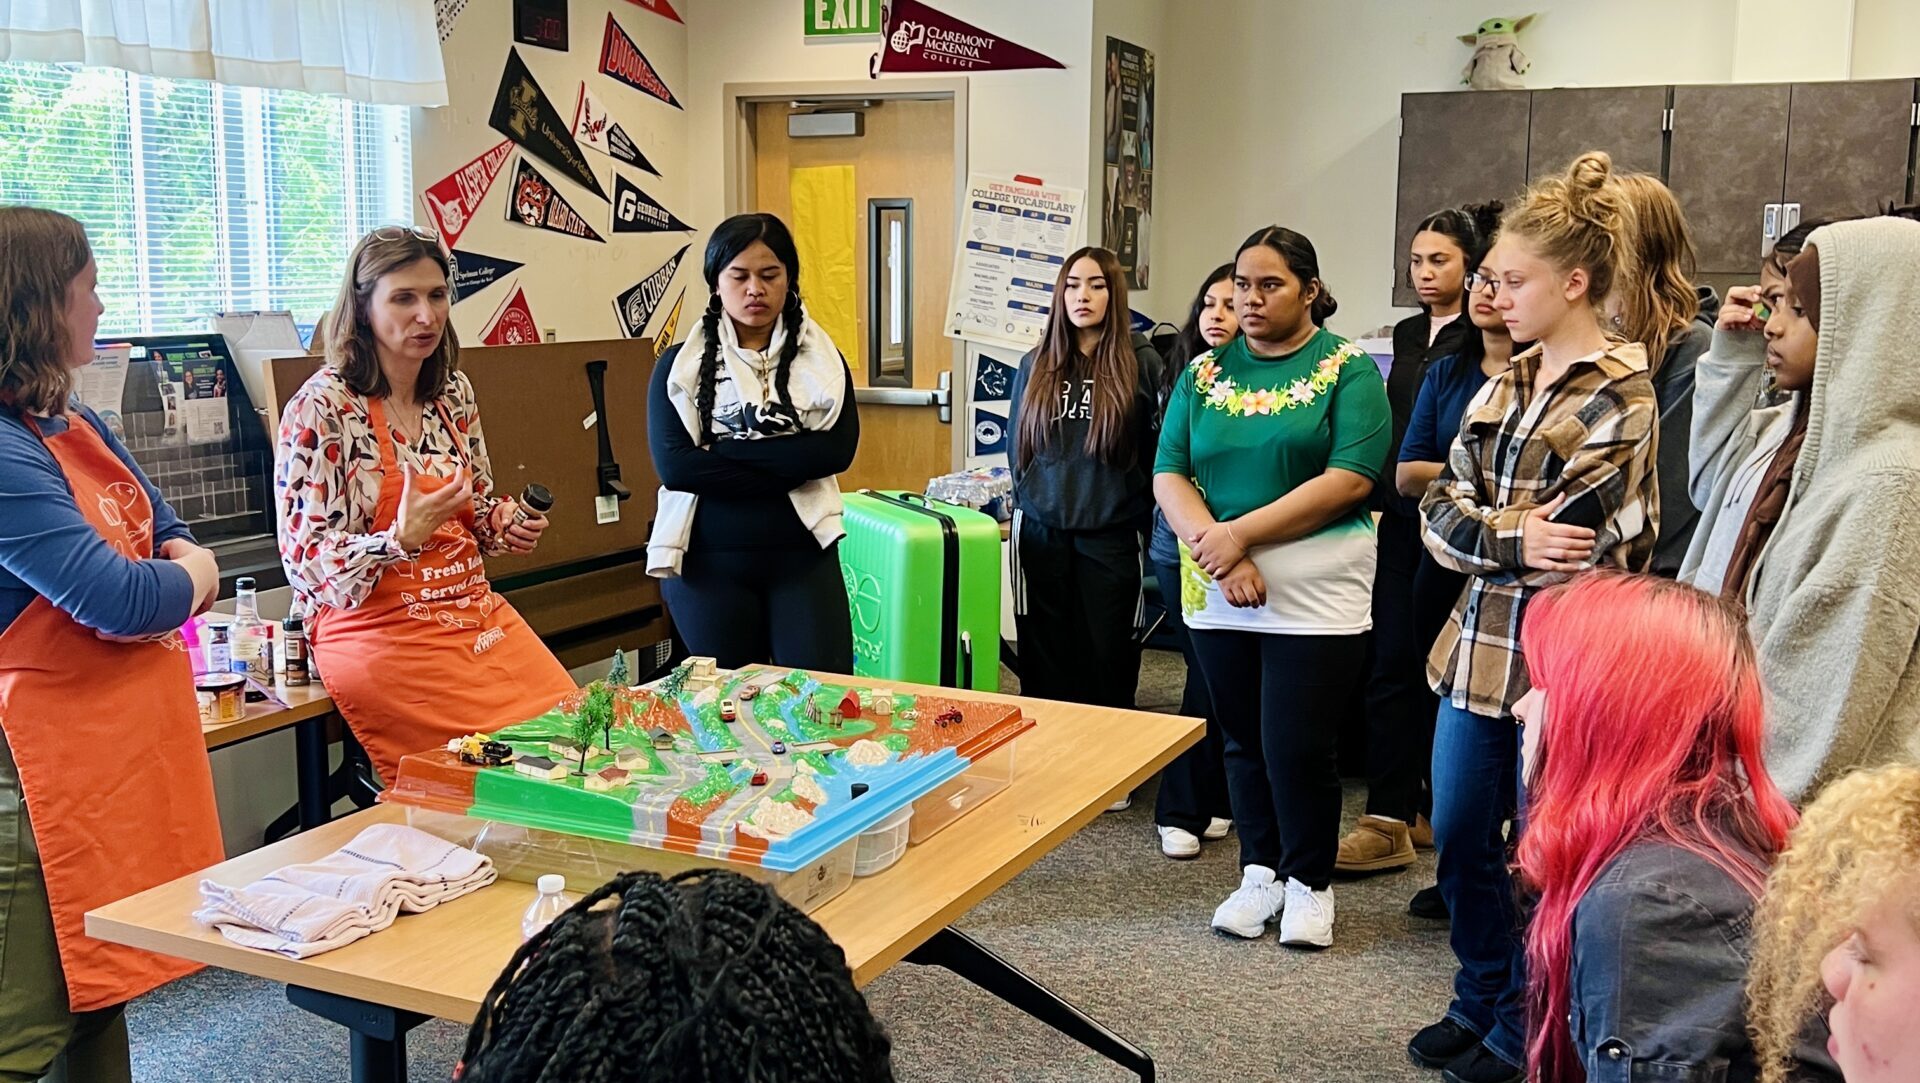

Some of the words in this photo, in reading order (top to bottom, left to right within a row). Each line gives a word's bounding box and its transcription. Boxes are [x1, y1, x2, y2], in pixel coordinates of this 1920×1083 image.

[815, 0, 870, 29] EXIT
[927, 26, 995, 49] CLAREMONT
[607, 23, 670, 103] DUQUESNE
[922, 52, 973, 68] COLLEGE
[454, 160, 491, 213] CASPER
[972, 188, 1011, 204] COLLEGE
[1013, 196, 1076, 214] VOCABULARY
[641, 258, 677, 314] CORBAN
[420, 560, 466, 582] Fresh
[420, 580, 467, 602] Served
